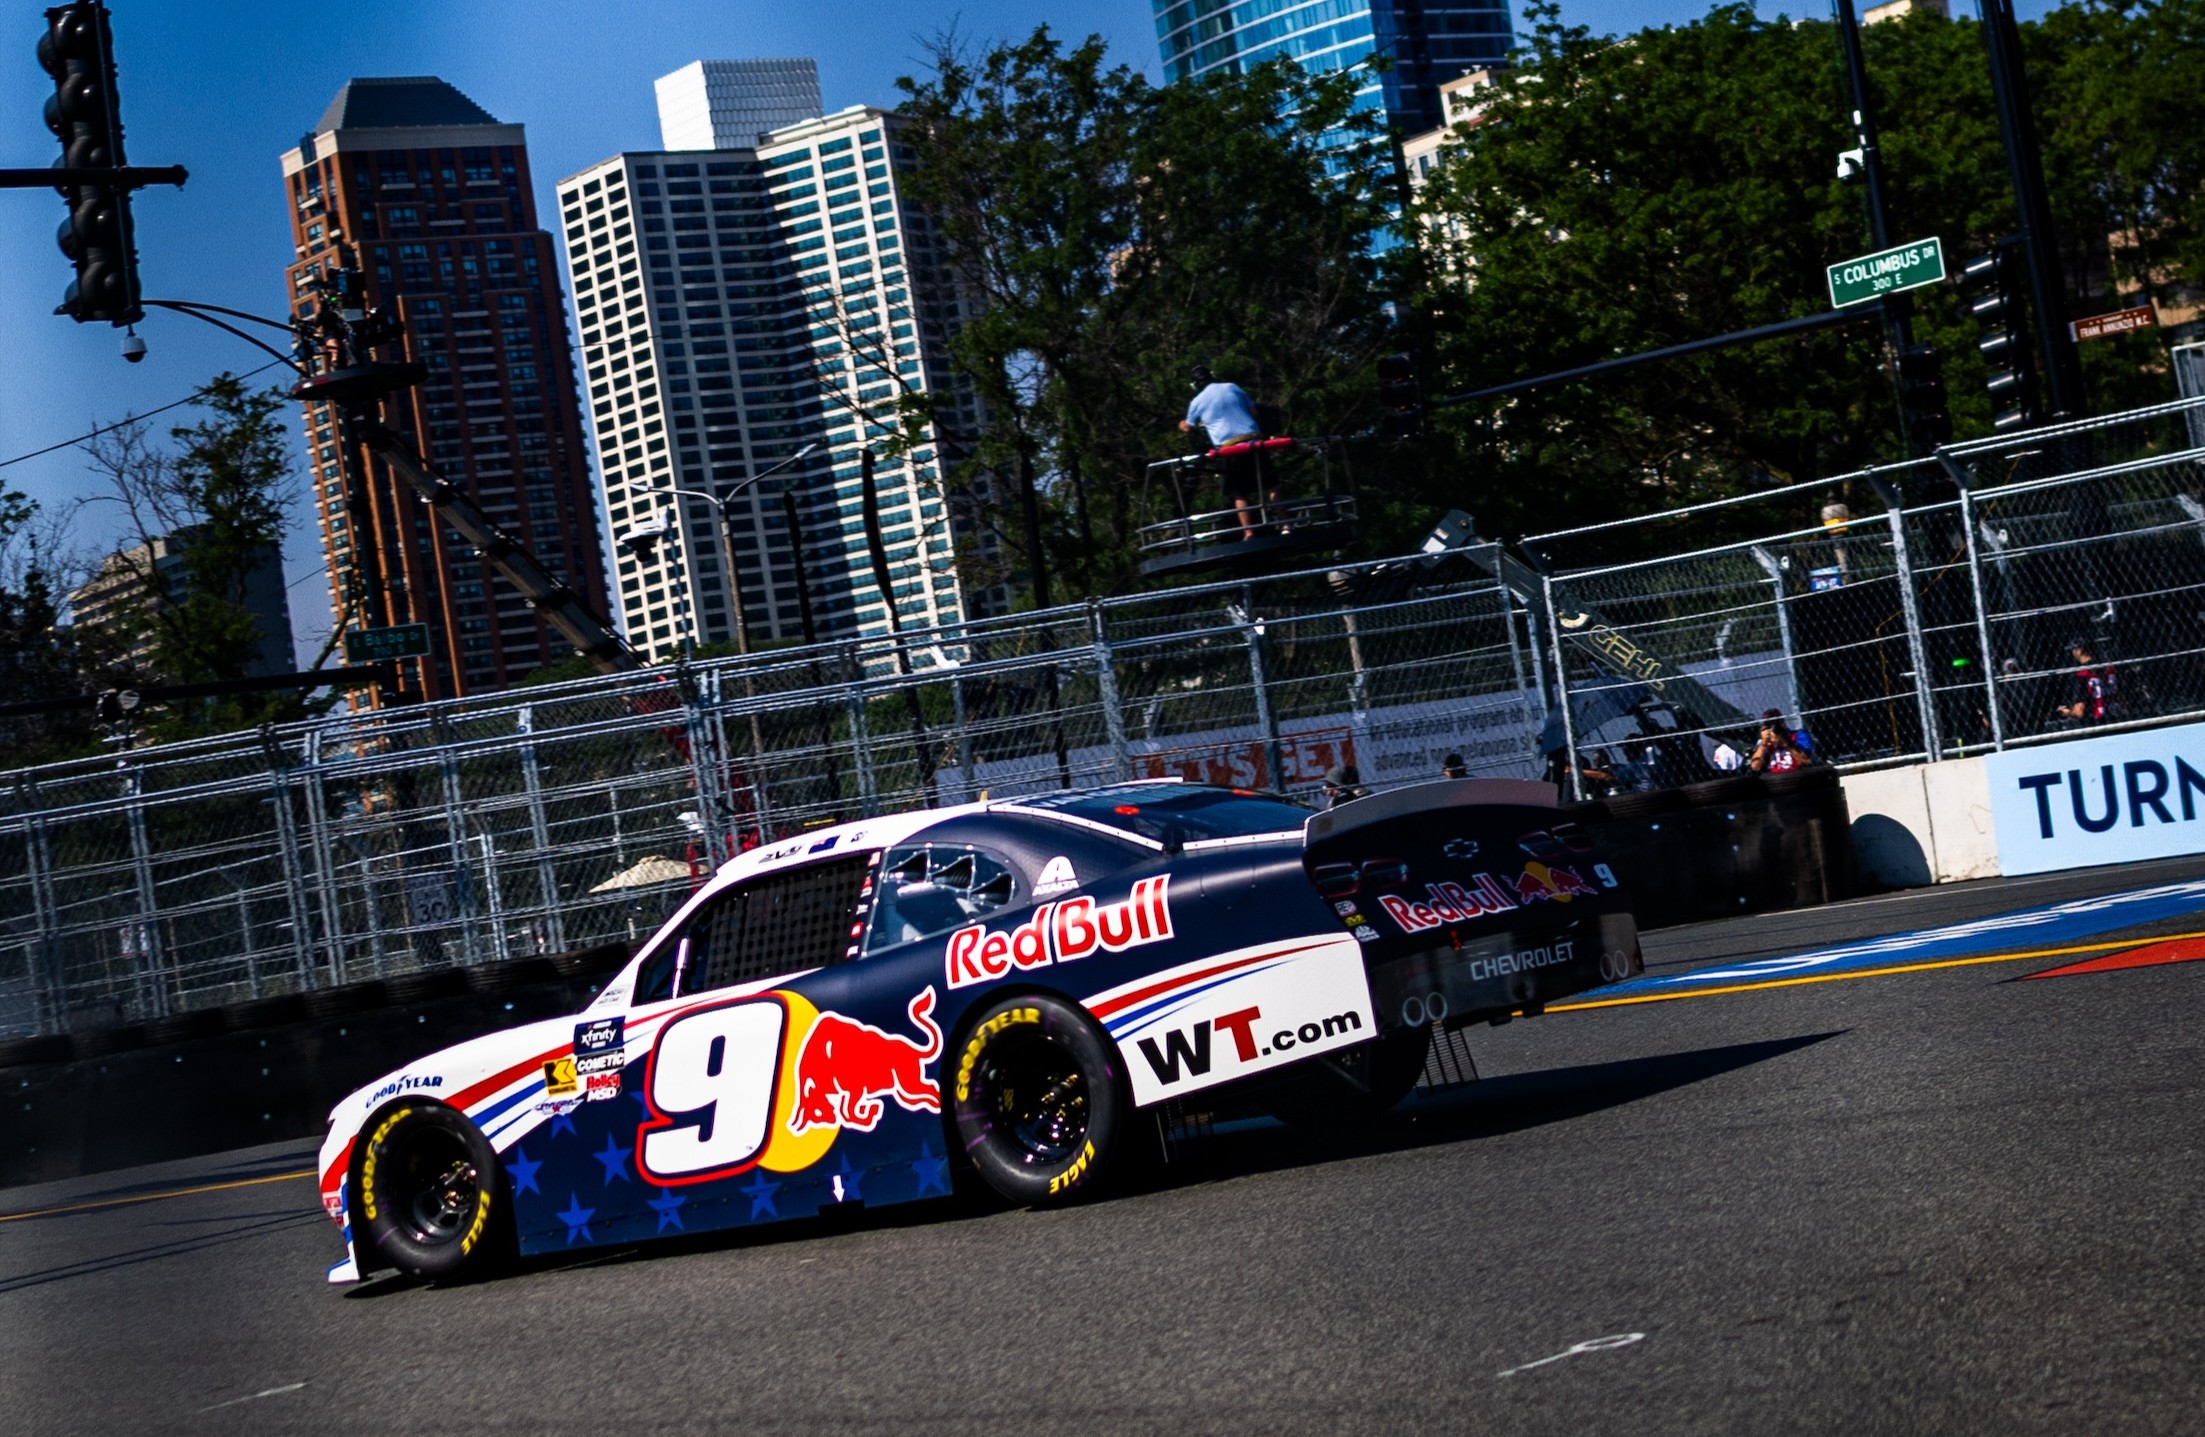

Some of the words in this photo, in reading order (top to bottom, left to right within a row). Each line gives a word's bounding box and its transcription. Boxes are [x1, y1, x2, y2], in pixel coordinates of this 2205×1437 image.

[1834, 274, 1841, 285] S
[1843, 249, 1920, 284] COLUMBUS
[1922, 246, 1935, 259] DR
[1872, 277, 1892, 291] 300
[1895, 273, 1903, 285] E
[1457, 710, 1506, 737] program
[1592, 862, 1619, 889] 9
[416, 901, 446, 923] 30
[1469, 941, 1574, 981] CHEVROLET
[581, 1028, 617, 1047] xfinity
[1136, 1006, 1362, 1086] WT.com
[577, 1051, 625, 1072] COMETIC
[956, 1007, 1041, 1102] GOODYEAR
[366, 1074, 443, 1108] GOODYEAR
[587, 1086, 617, 1102] MSD
[641, 999, 788, 1177] 9
[1049, 1139, 1096, 1195] EAGLE
